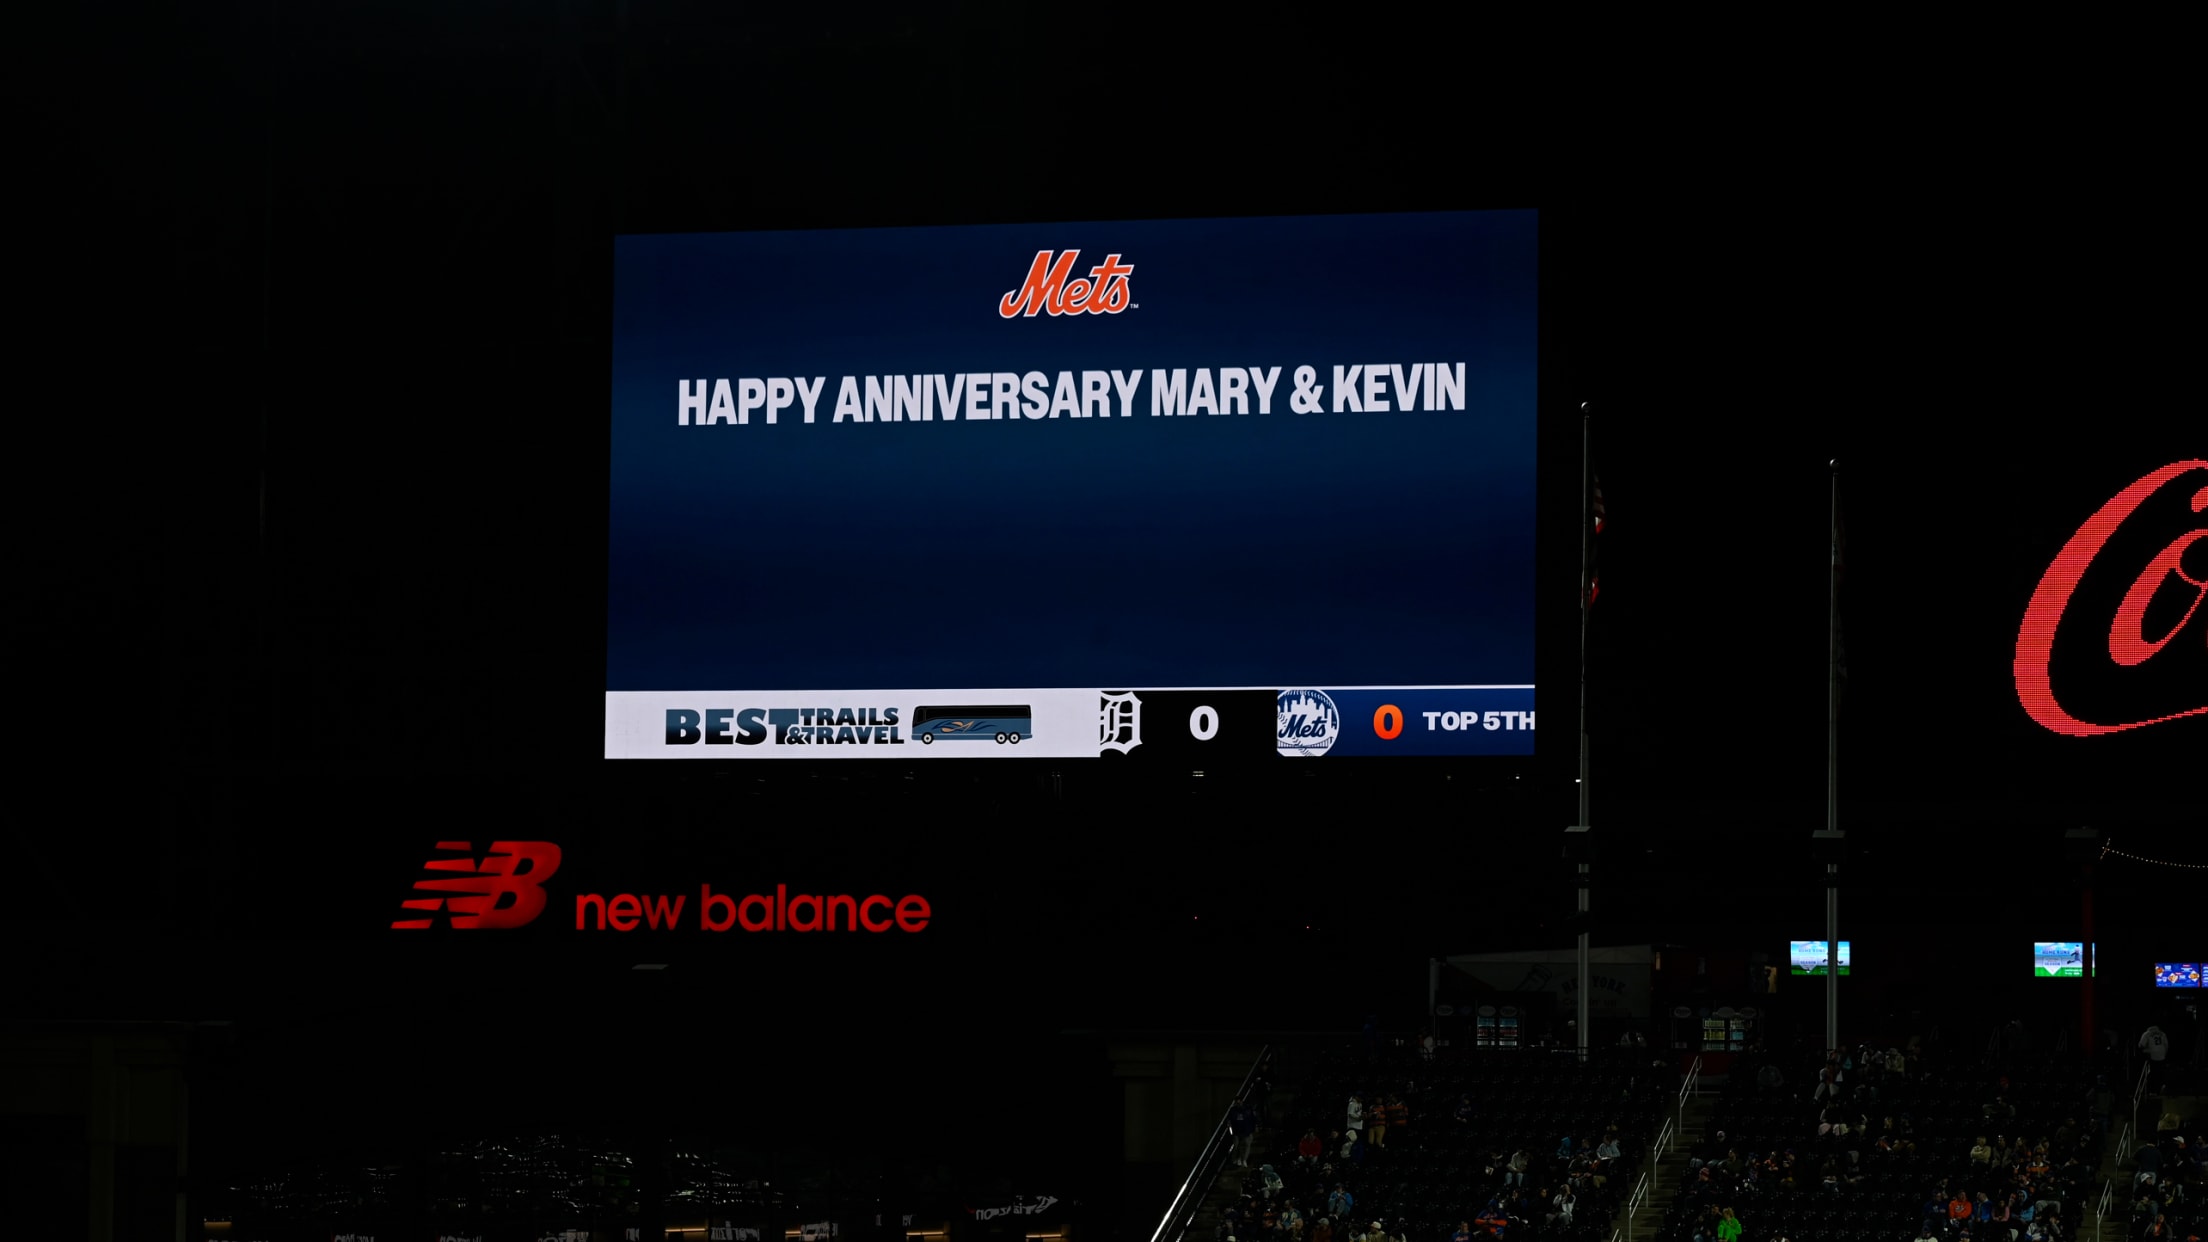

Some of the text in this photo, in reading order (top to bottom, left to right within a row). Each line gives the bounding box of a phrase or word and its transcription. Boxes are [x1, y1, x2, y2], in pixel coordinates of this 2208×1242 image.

[999, 249, 1135, 318] Mets
[678, 362, 1466, 426] HAPPY ANNIVERSARY MARY & KEVIN
[665, 707, 899, 745] BEST TRAILS
[1189, 705, 1219, 741] 0
[1278, 714, 1327, 738] Mets
[1373, 704, 1404, 740] 0
[1422, 710, 1535, 731] TOP 5TH
[391, 840, 562, 929] NB
[576, 883, 932, 932] new balance
